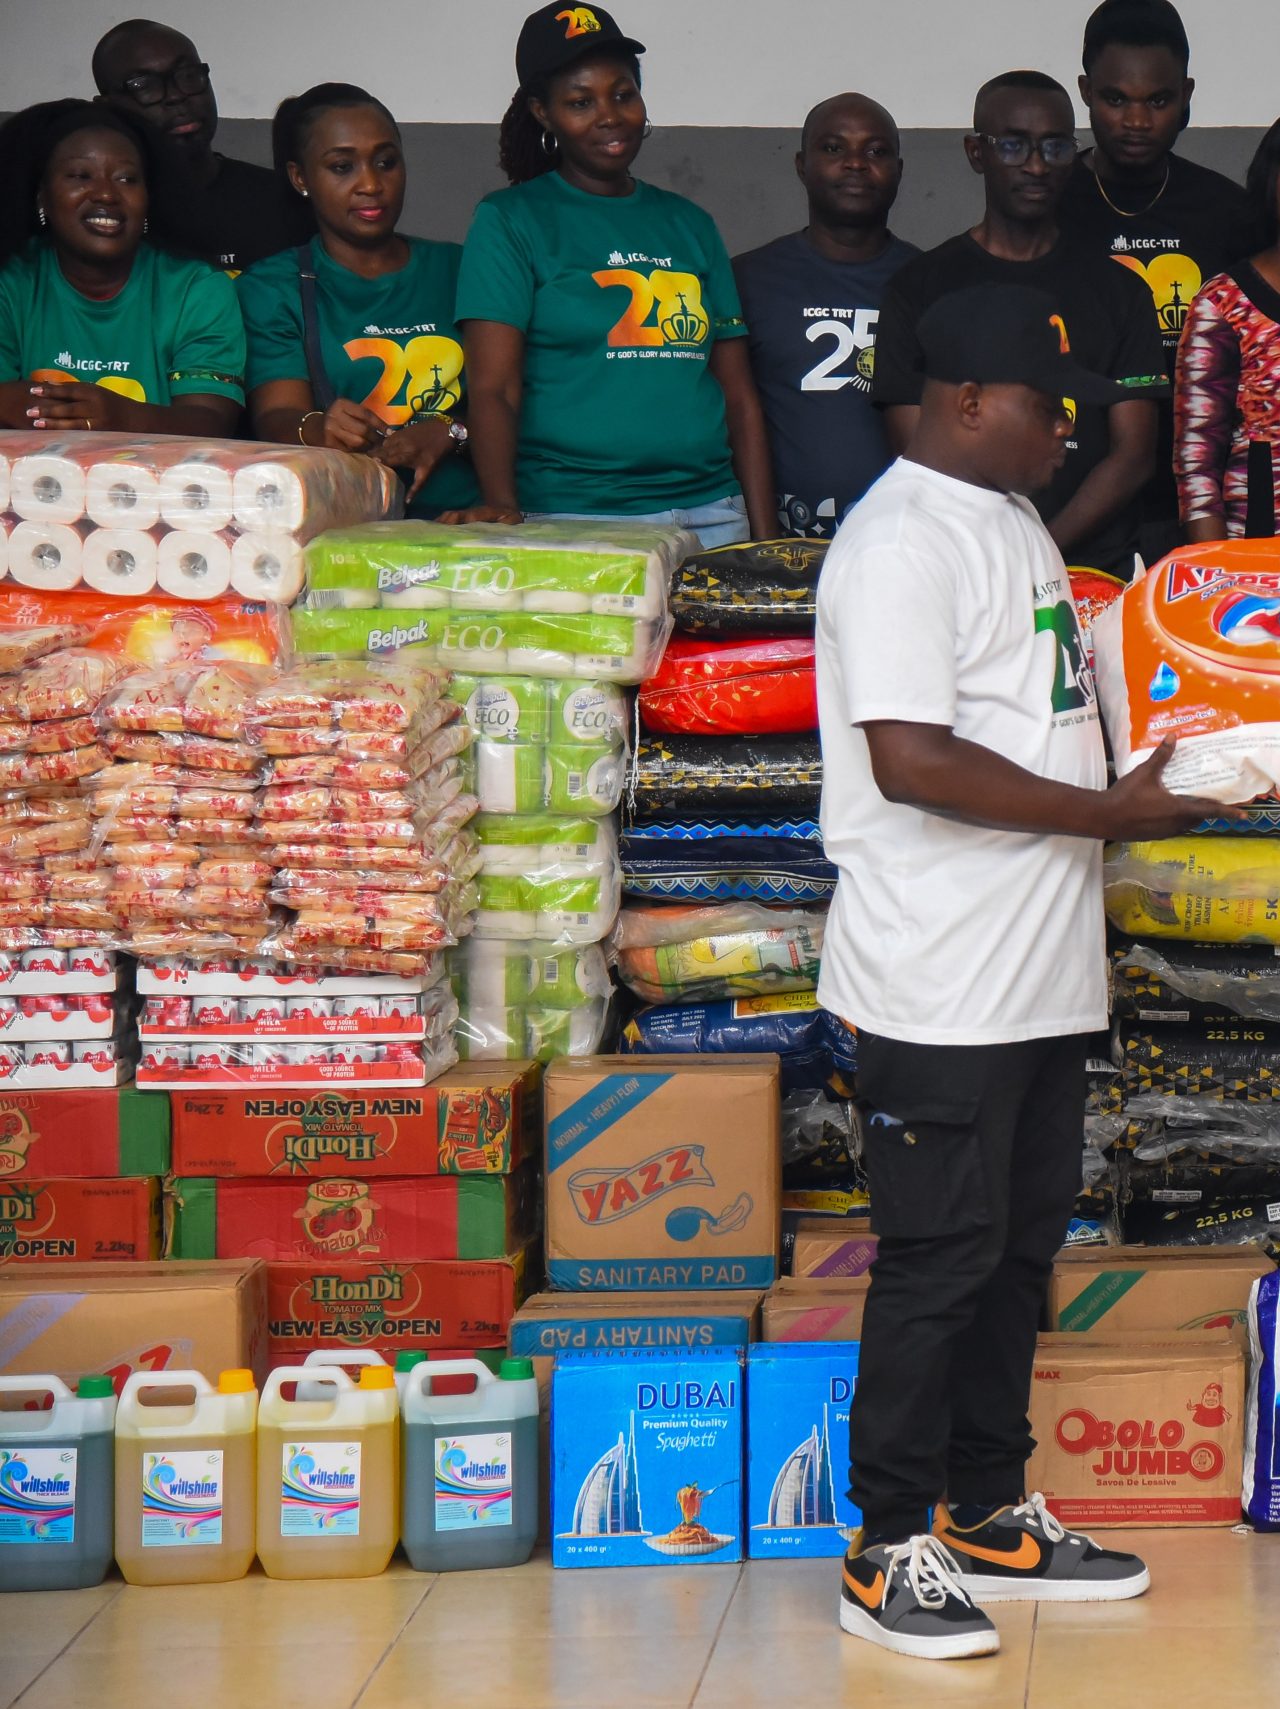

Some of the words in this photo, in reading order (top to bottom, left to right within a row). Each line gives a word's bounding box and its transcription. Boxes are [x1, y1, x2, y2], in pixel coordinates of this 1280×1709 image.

[1131, 238, 1181, 249] ICGC-TRT
[803, 307, 830, 317] ICGC
[831, 308, 854, 318] TRT
[384, 323, 437, 335] ICGC-TRT
[606, 350, 615, 359] OF
[617, 350, 637, 359] GOD'S
[639, 351, 658, 359] GLORY
[75, 358, 130, 372] ICGC-TRT
[378, 560, 441, 590] Belpak
[451, 565, 516, 595] ECO
[367, 619, 429, 652] Belpak
[441, 624, 504, 652] ECO
[572, 711, 607, 728] ECO
[1265, 911, 1278, 921] 5
[338, 1017, 359, 1026] SOURCE
[1243, 1031, 1265, 1041] KG
[253, 1065, 277, 1073] MILK
[334, 1064, 355, 1073] SOURCE
[615, 1077, 641, 1101] FLOW
[244, 1099, 306, 1118] OPEN
[305, 1098, 367, 1117] EASY
[371, 1098, 423, 1117] NEW
[304, 1123, 321, 1132] MIX
[322, 1122, 364, 1132] TOMATO
[284, 1134, 376, 1162] HonDi
[314, 1181, 362, 1198] ROSA
[581, 1150, 694, 1222] YAZZ
[1231, 1207, 1254, 1219] KG
[13, 1240, 75, 1256] OPEN
[94, 1240, 136, 1255] 2.2kg
[577, 1266, 694, 1286] SANITARY
[700, 1264, 747, 1284] PAD
[310, 1272, 404, 1301] HonDi
[322, 1304, 359, 1314] TOMATO
[359, 1304, 383, 1314] MIX
[268, 1319, 318, 1337] NEW
[318, 1319, 377, 1337] EASY
[376, 1318, 442, 1337] OPEN
[460, 1320, 501, 1334] 2.2kg
[594, 1324, 714, 1346] SANITARY
[540, 1326, 587, 1348] PAD
[637, 1380, 736, 1411] DUBAI
[642, 1418, 689, 1430] Premium
[689, 1418, 728, 1433] Quality
[656, 1430, 717, 1453] Spaghetti
[1091, 1439, 1226, 1481] JUMBO
[308, 1467, 356, 1486] willshine
[460, 1462, 507, 1480] willshine
[20, 1474, 71, 1493] willshine
[169, 1477, 218, 1496] willshine
[1096, 1478, 1125, 1486] Savon
[1127, 1478, 1140, 1486] De
[566, 1545, 577, 1553] 20
[583, 1544, 599, 1552] 400
[762, 1537, 772, 1545] 20
[779, 1536, 793, 1544] 400
